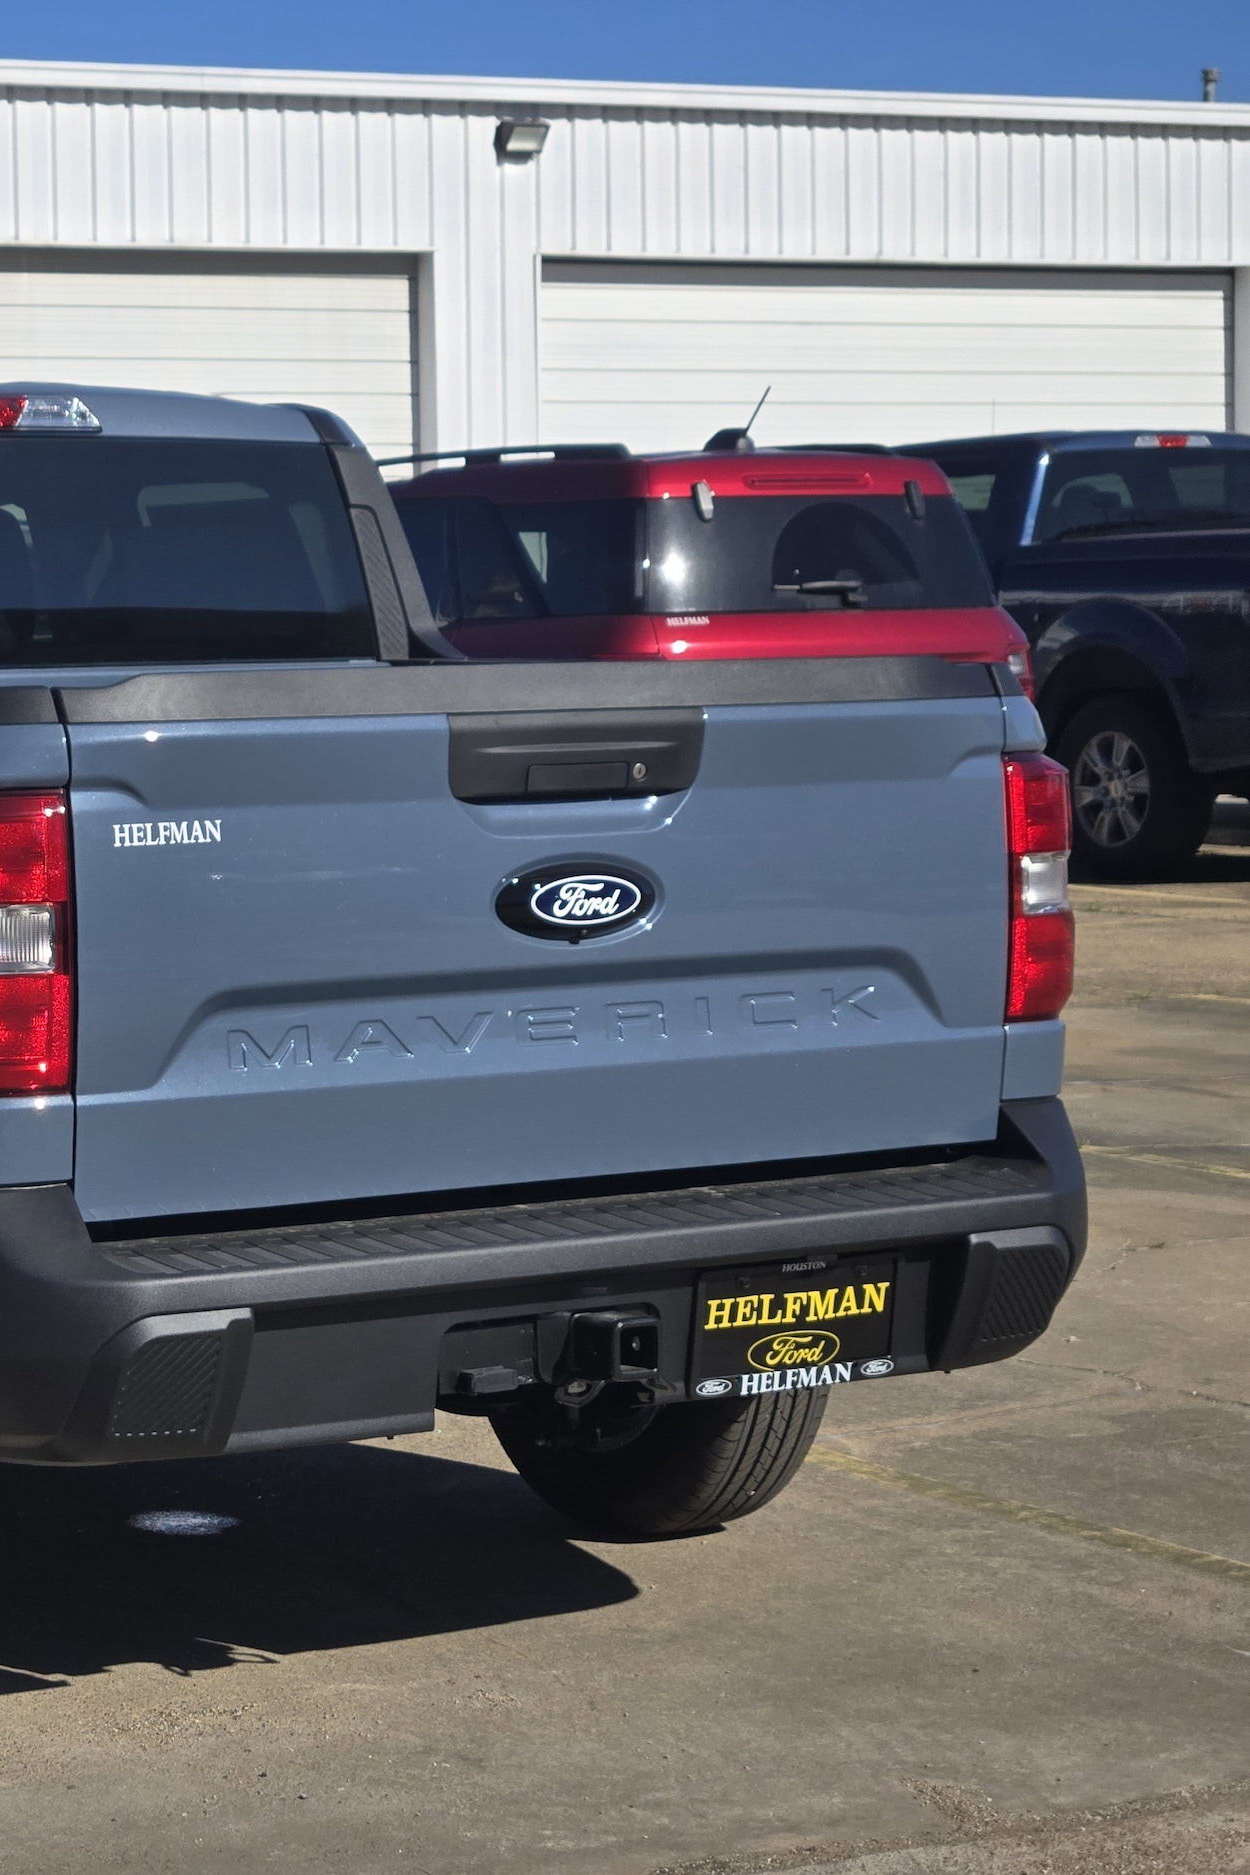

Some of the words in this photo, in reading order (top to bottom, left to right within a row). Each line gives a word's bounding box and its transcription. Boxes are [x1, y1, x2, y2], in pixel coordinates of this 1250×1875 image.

[113, 819, 222, 847] HELFMAN
[553, 882, 621, 917] Ford
[227, 985, 880, 1071] MAVERICK
[782, 1260, 827, 1272] HOUSTON
[704, 1281, 891, 1330] HELFMAN
[766, 1336, 826, 1365] Ford
[740, 1362, 854, 1396] HELFMAN
